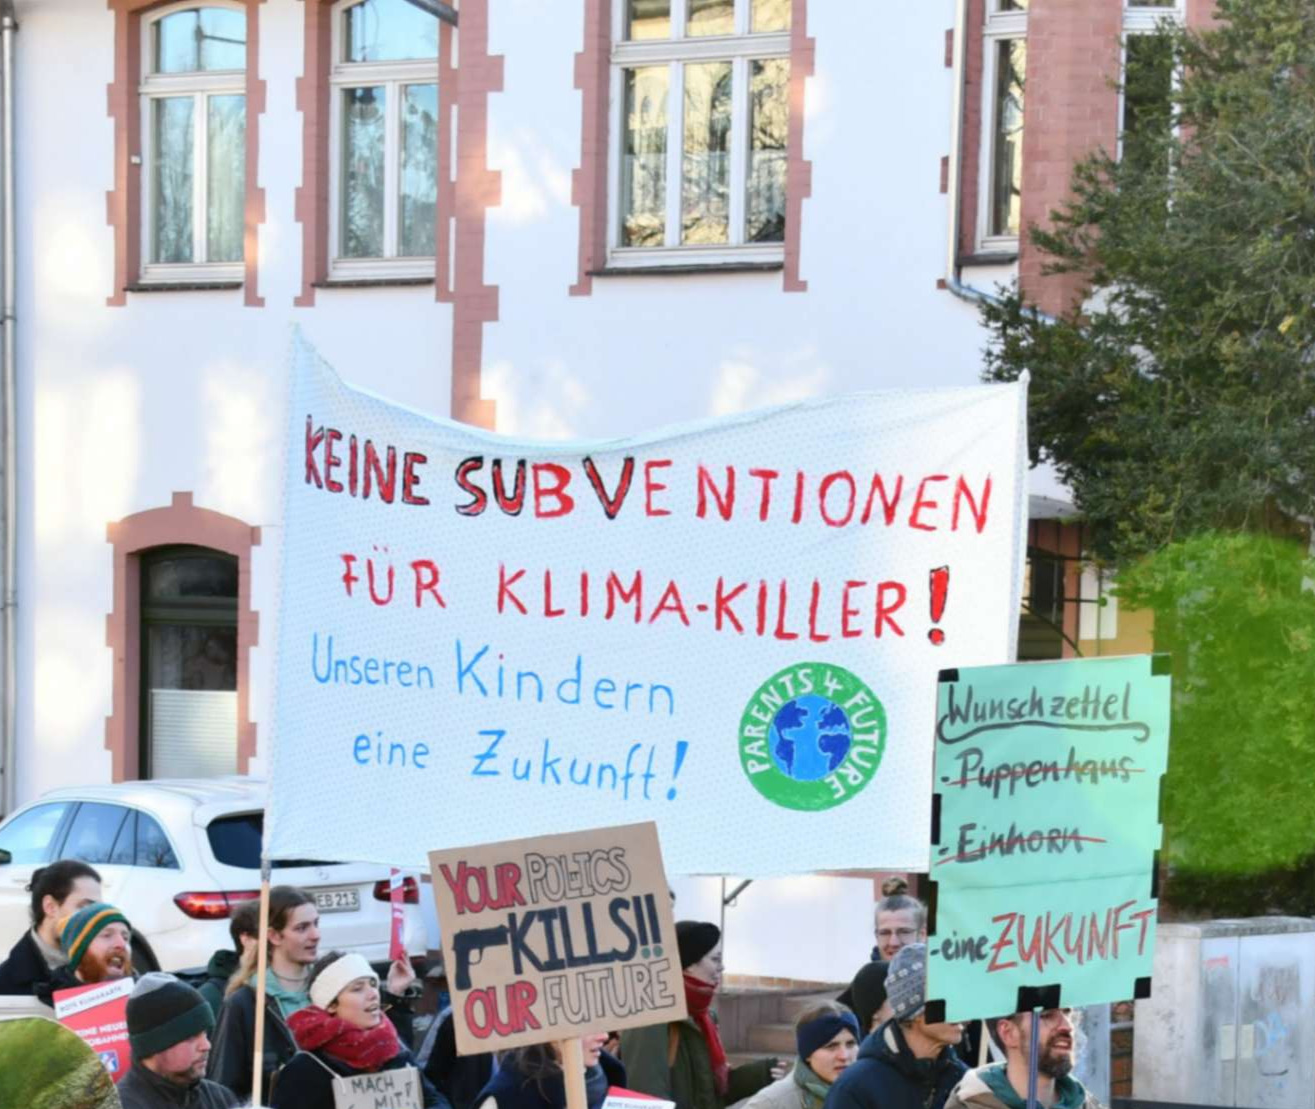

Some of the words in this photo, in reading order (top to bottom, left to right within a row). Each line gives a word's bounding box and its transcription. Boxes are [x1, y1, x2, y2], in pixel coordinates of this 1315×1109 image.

[304, 414, 431, 506] KEINE
[454, 455, 993, 534] SUBVENTIONEN
[340, 543, 446, 609] FÜR
[497, 562, 951, 647] KLIMA-KILLER!
[311, 631, 435, 690] Unseren
[454, 638, 676, 717] Kindern
[823, 670, 844, 698] 4
[743, 667, 814, 776] PARENTS
[824, 688, 881, 800] FUTURE
[352, 731, 431, 770] eine
[470, 729, 690, 802] Zukunft!
[438, 860, 528, 915] YOUR
[506, 892, 665, 977] KILLS!!
[986, 899, 1155, 974] ZUKUNFT
[463, 979, 543, 1041] OUR
[542, 957, 677, 1027] FUTURE
[350, 1075, 396, 1095] MACH
